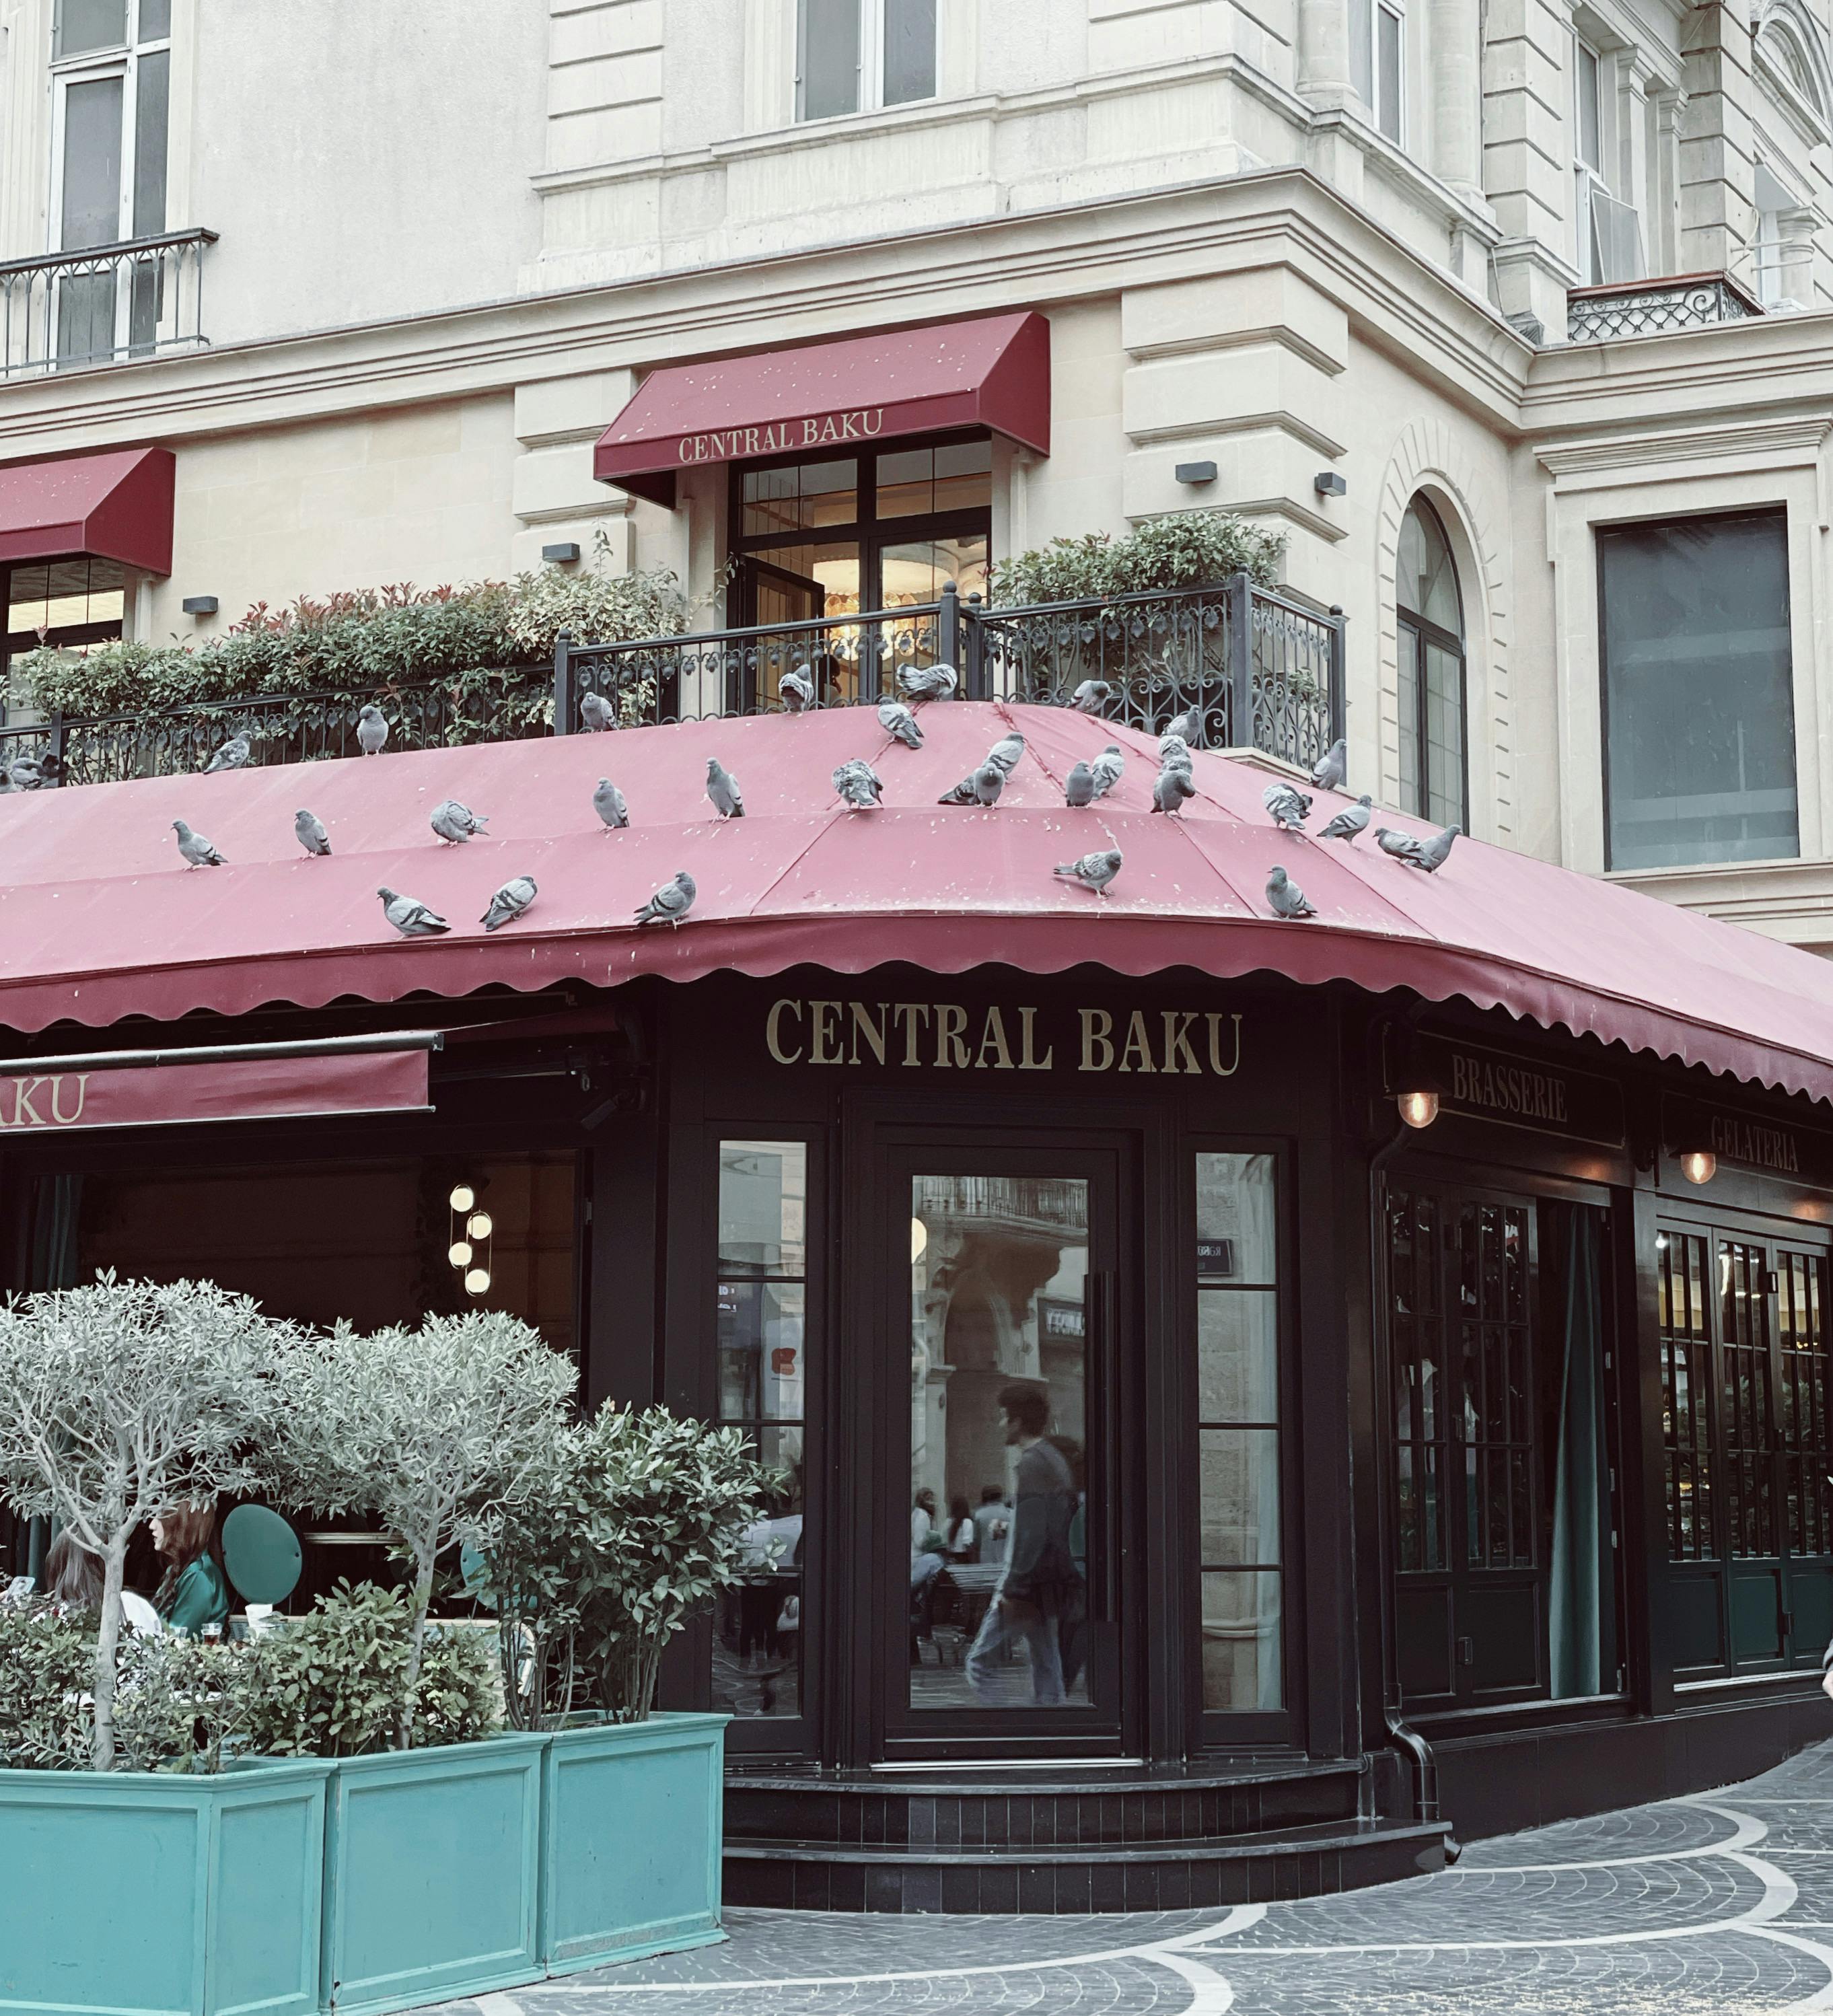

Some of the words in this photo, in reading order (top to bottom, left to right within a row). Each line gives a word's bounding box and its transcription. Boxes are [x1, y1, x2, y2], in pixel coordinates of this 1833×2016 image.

[679, 423, 793, 463] CENTRAL
[801, 408, 884, 445] BAKU
[766, 999, 1053, 1069] CENTRAL
[1077, 1009, 1243, 1075] BAKU
[1451, 1054, 1567, 1122] BRASSERIE
[1711, 1115, 1799, 1172] GELATERIA
